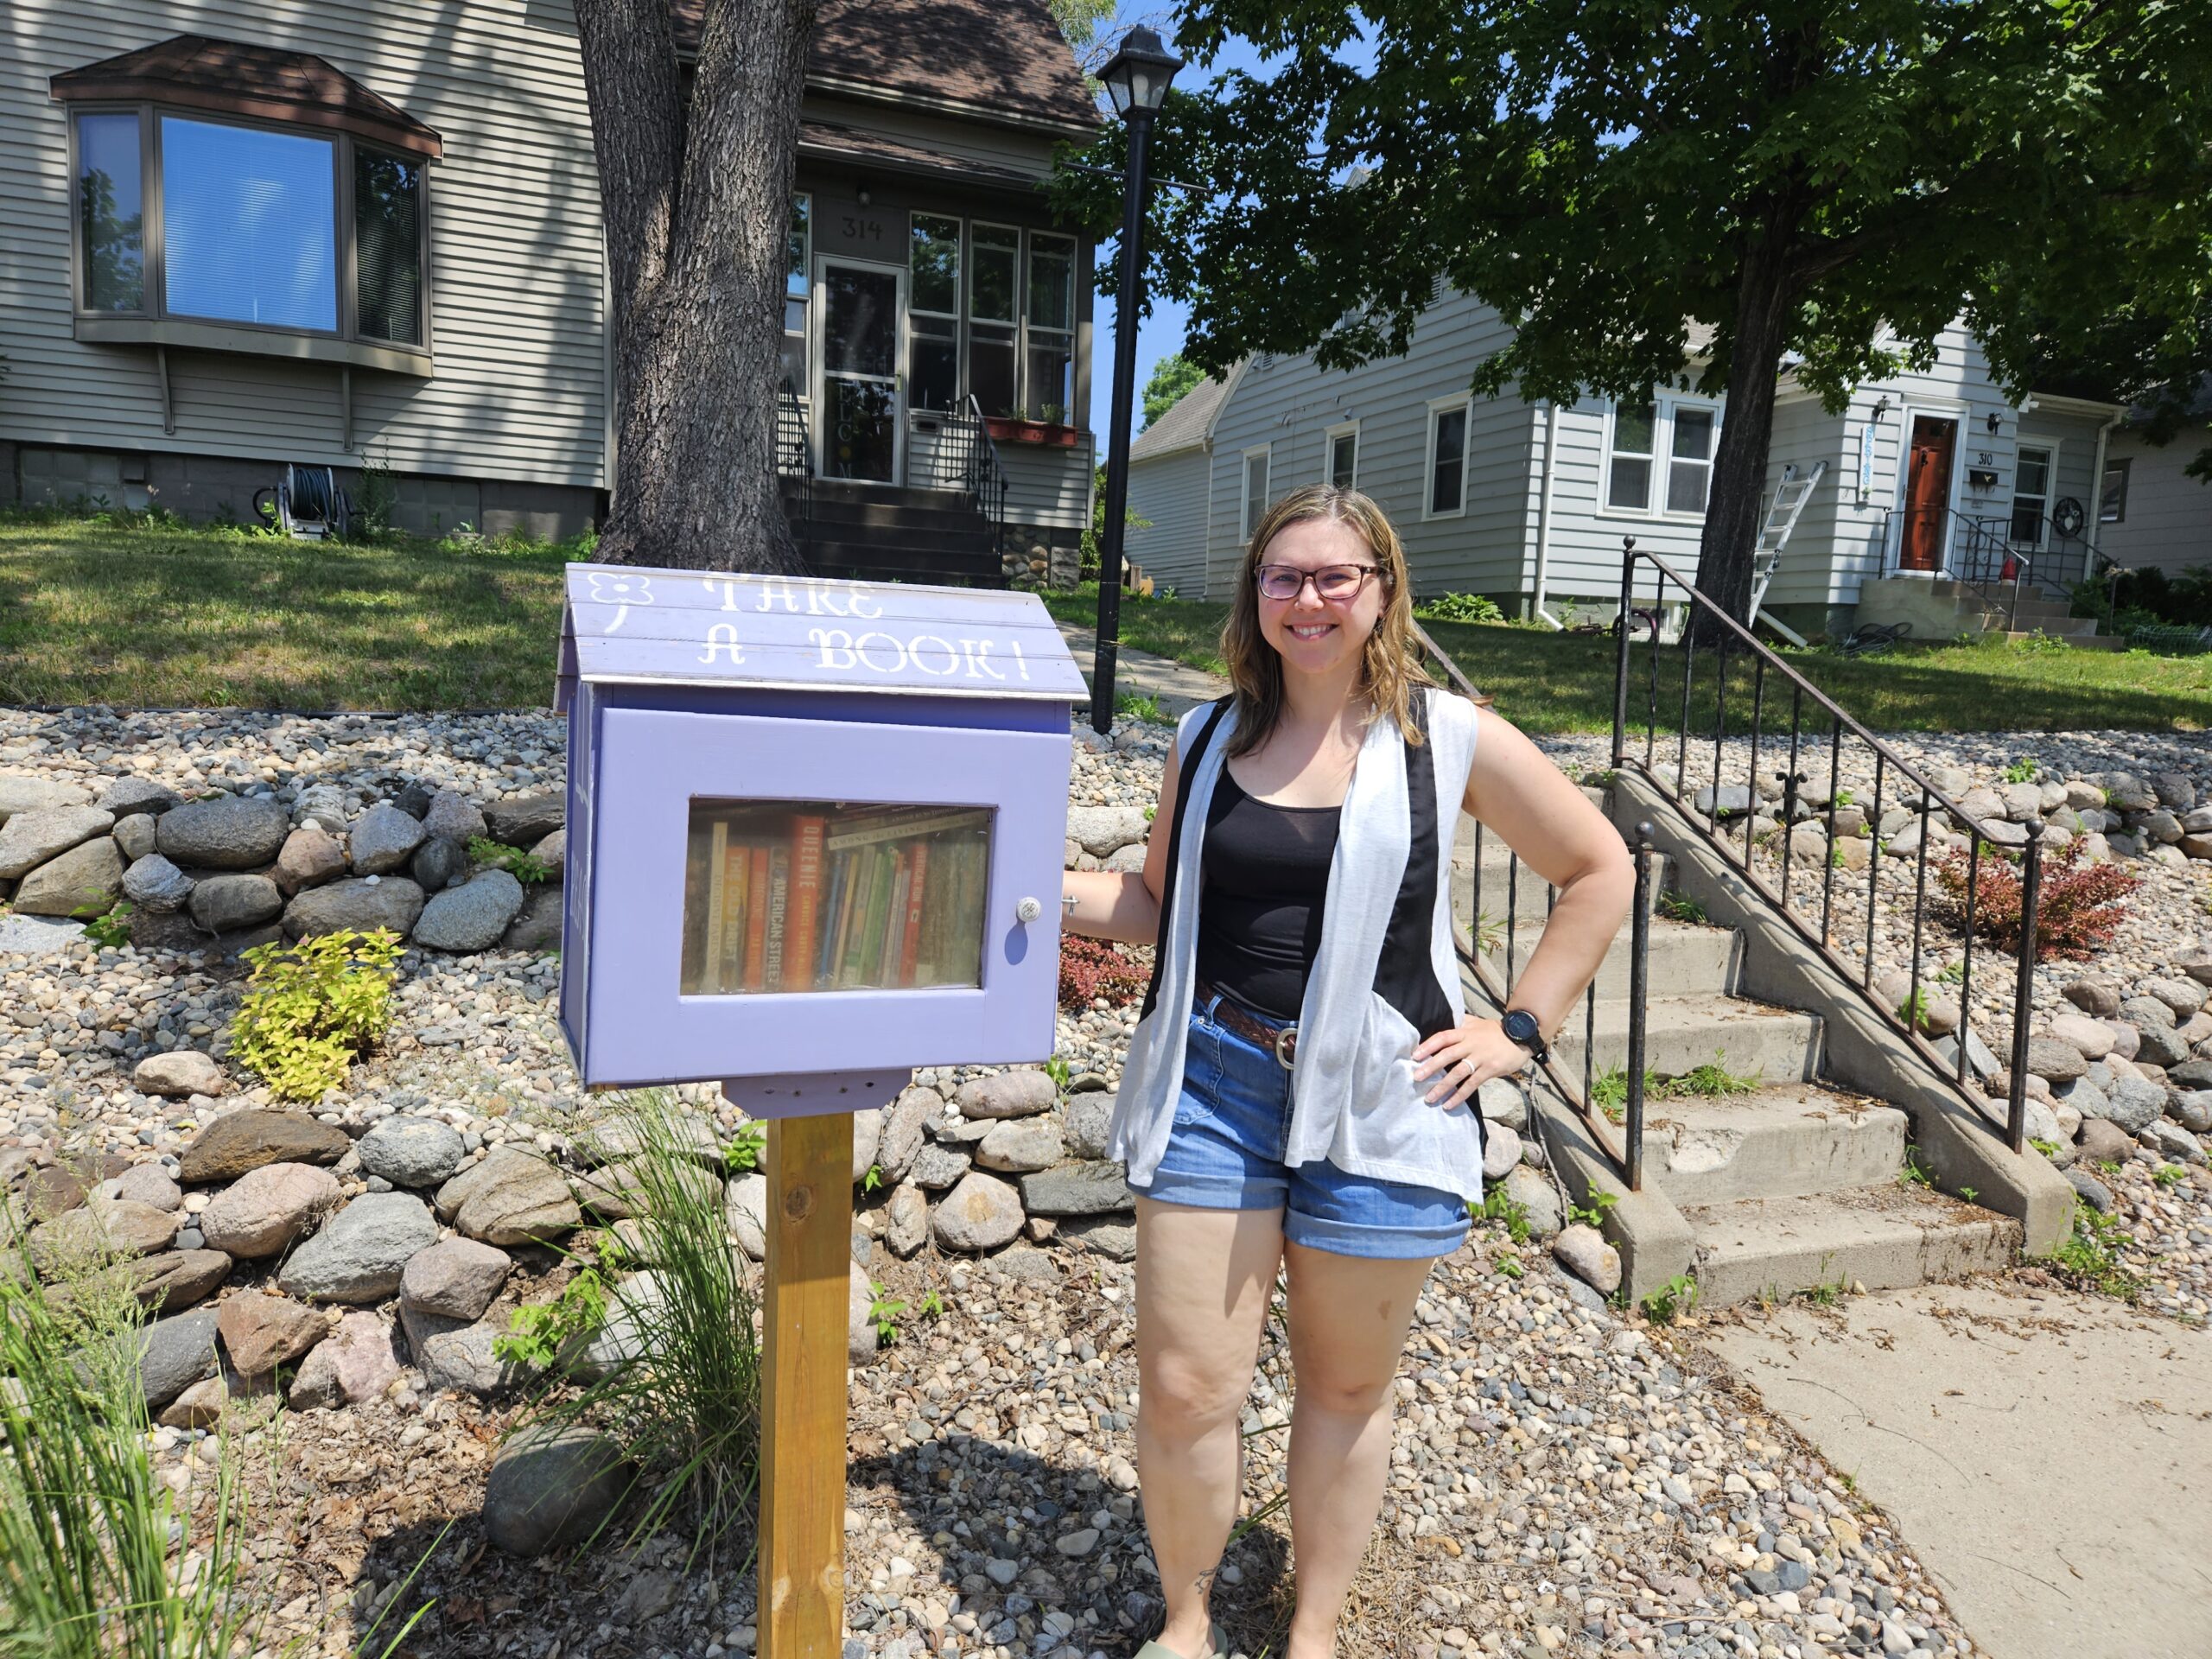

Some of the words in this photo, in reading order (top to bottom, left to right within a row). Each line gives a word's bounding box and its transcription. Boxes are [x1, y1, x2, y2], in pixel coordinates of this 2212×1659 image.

[842, 217, 883, 241] 314
[1979, 452, 1993, 466] 310
[702, 572, 883, 619] TAKE
[697, 623, 746, 664] A
[808, 627, 1030, 681] BOOK!
[728, 855, 742, 881] THE
[798, 825, 820, 889] QUEENIE
[727, 886, 740, 917] OLD
[770, 877, 785, 939] AMERICAN
[912, 886, 923, 902] RUN
[725, 920, 739, 963] DRIFT
